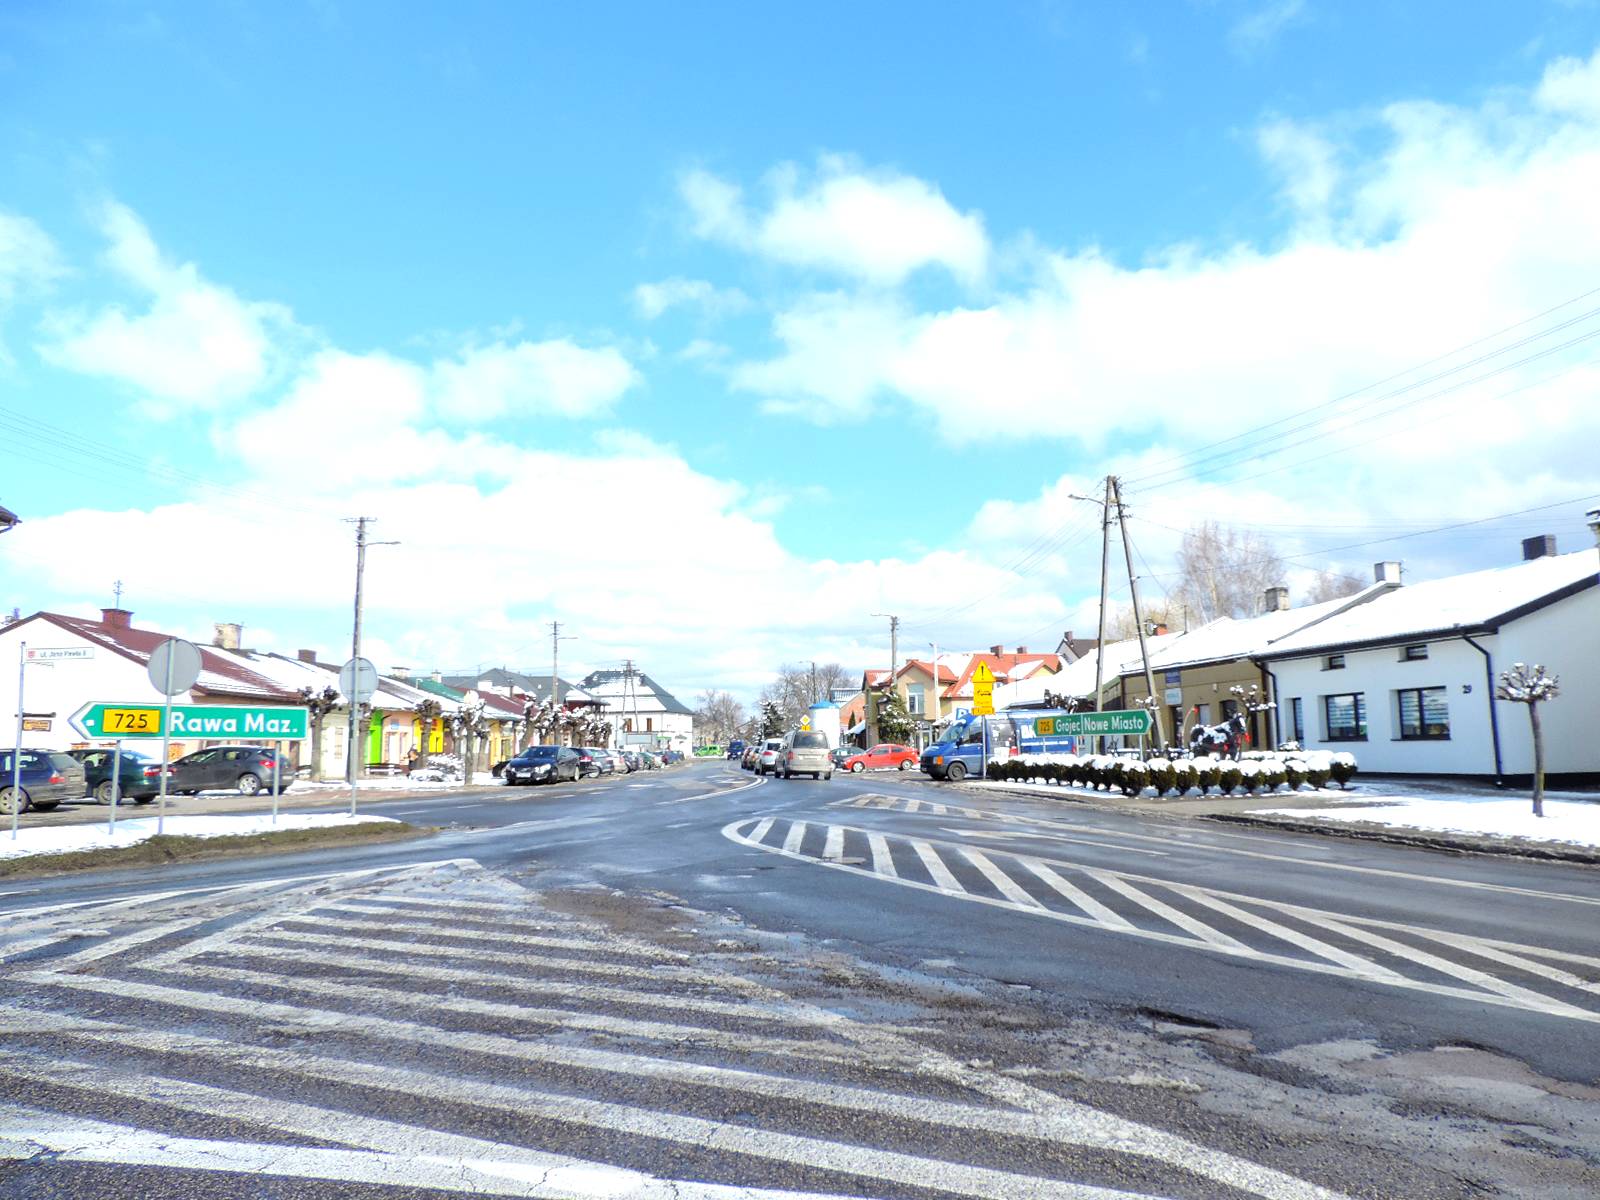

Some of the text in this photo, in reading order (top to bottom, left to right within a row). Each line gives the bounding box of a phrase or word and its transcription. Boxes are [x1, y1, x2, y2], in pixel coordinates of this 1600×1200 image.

[114, 712, 298, 734] 725 Rawa Maz.
[1084, 717, 1108, 732] Nowe
[1111, 715, 1144, 730] Miasto
